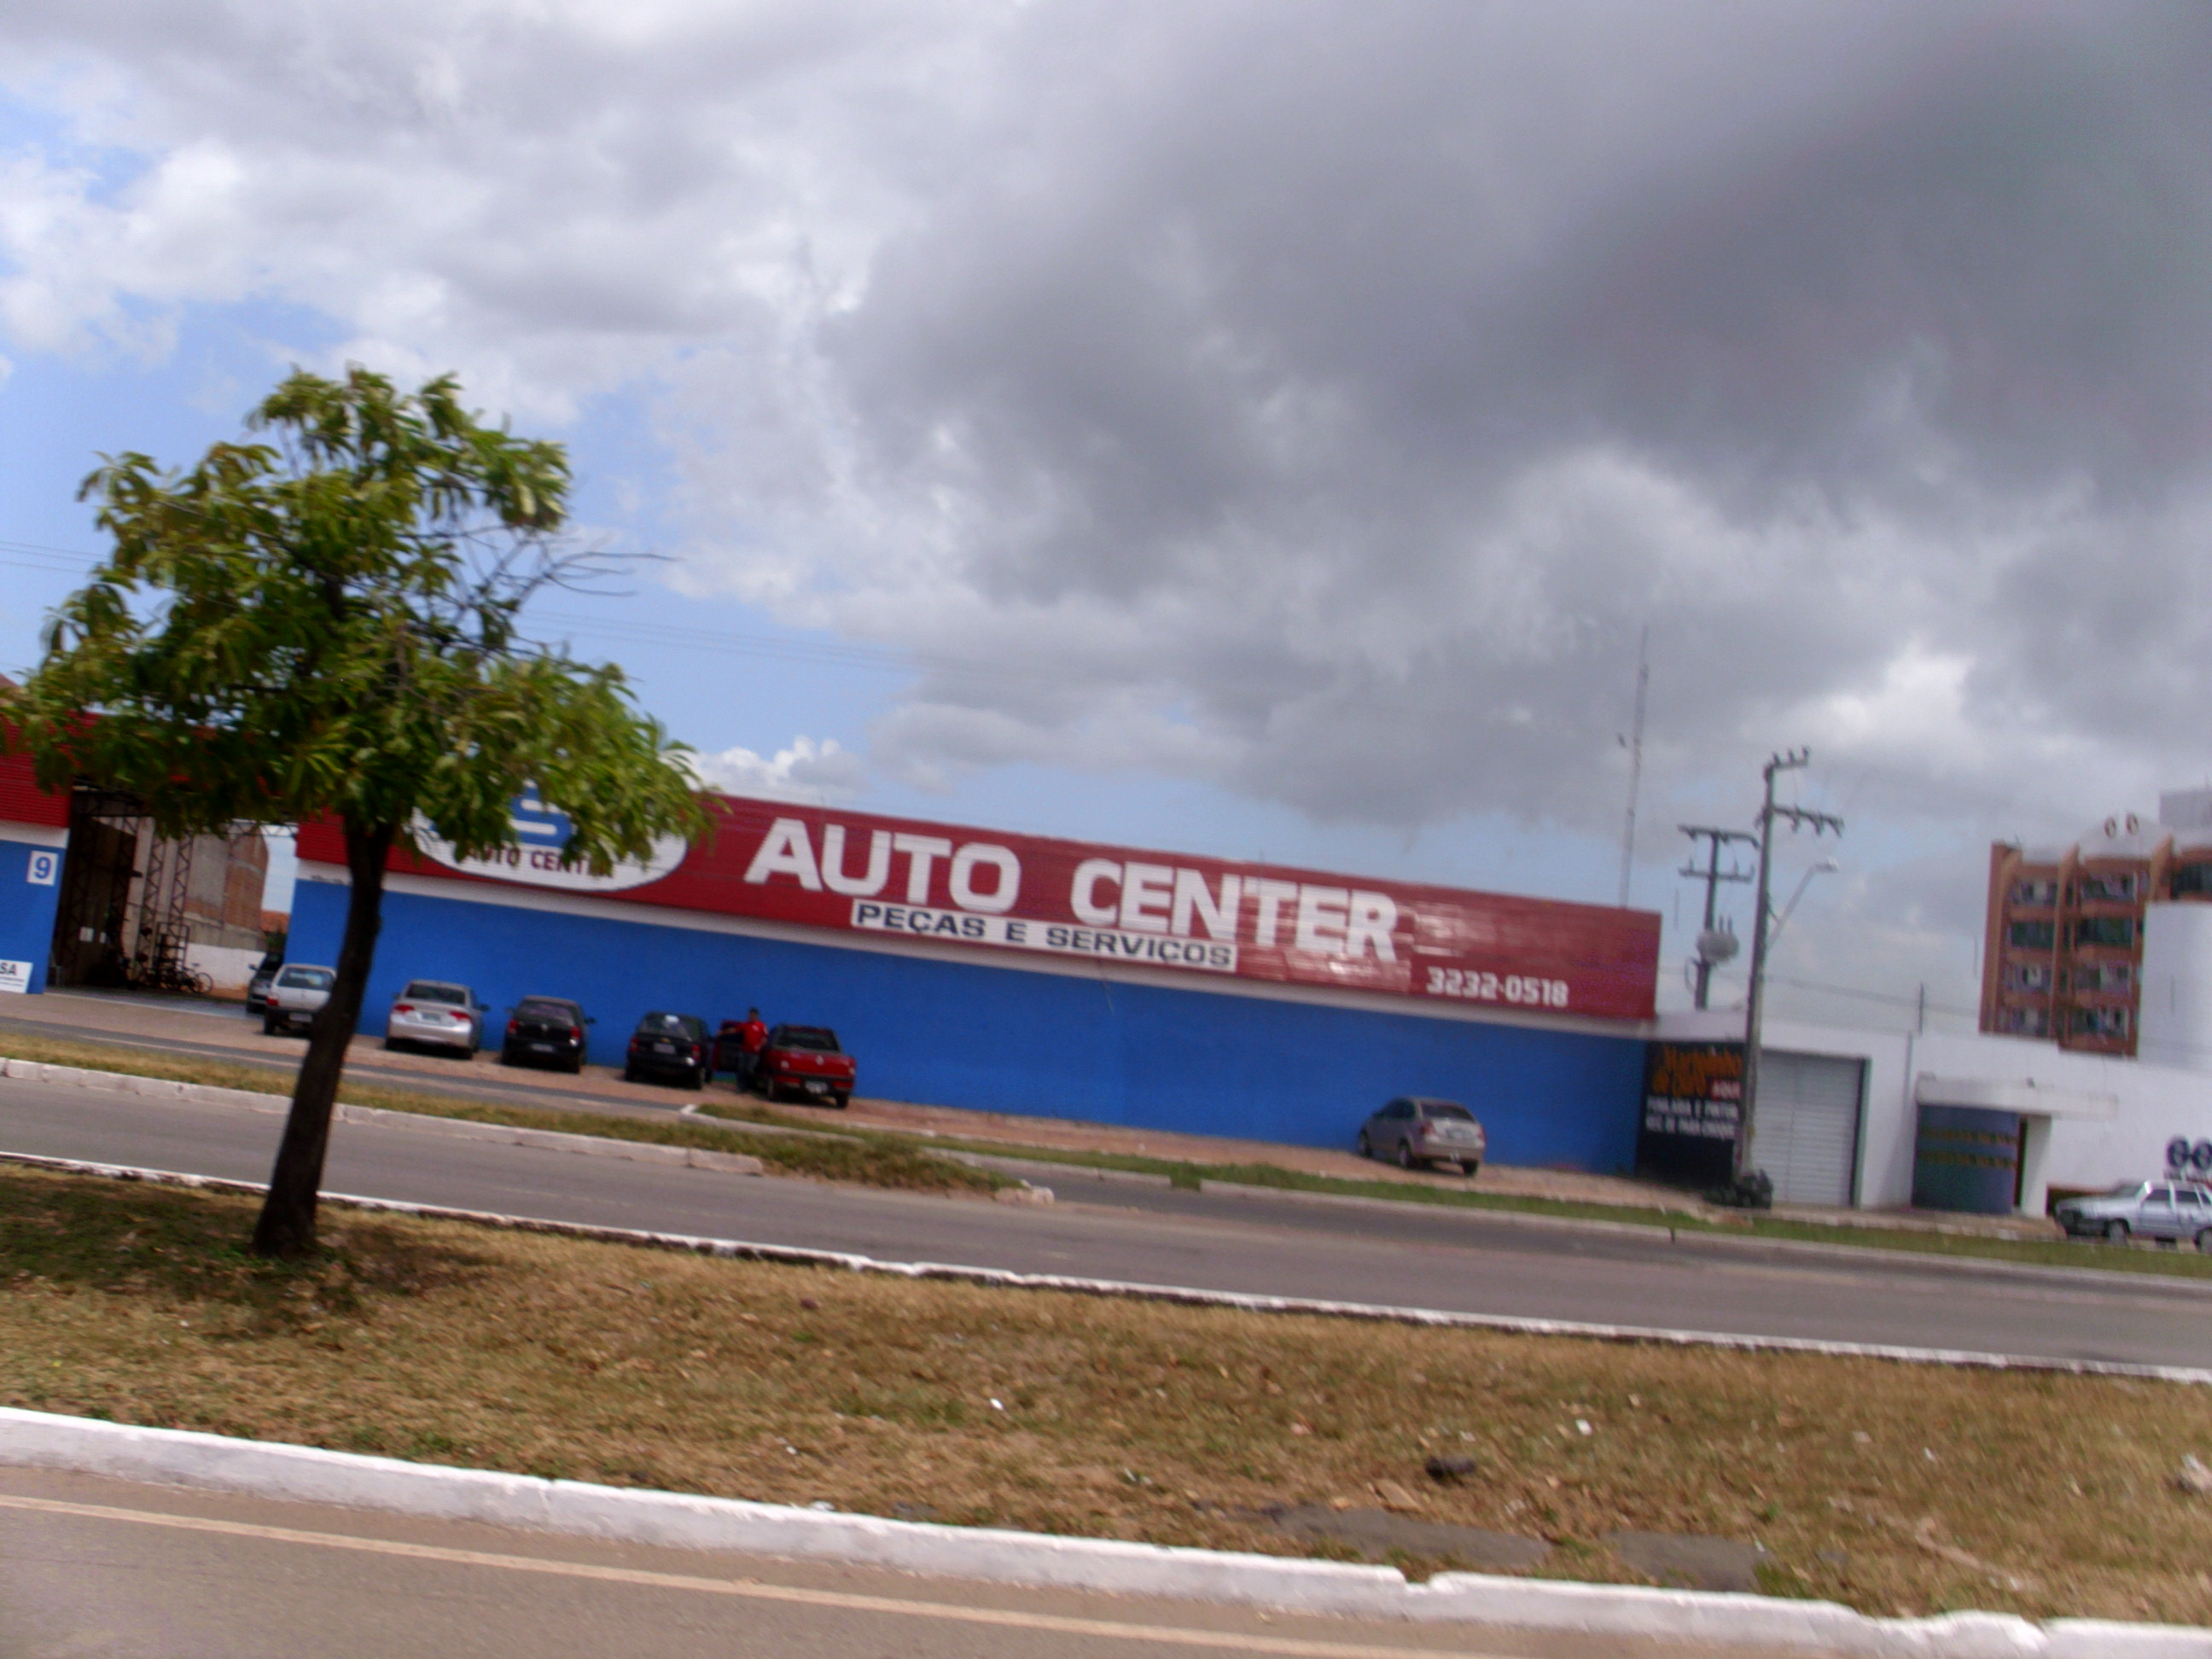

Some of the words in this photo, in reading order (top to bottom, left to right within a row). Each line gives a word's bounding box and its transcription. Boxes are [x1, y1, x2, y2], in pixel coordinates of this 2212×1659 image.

[34, 856, 51, 879] 9
[743, 817, 1021, 913] AUTO
[1070, 858, 1398, 963] CENTER
[857, 903, 986, 938] PEÇAS
[1005, 922, 1027, 942] E
[1045, 926, 1231, 967] SERVIÇOS
[1426, 965, 1569, 1008] 3232-0518
